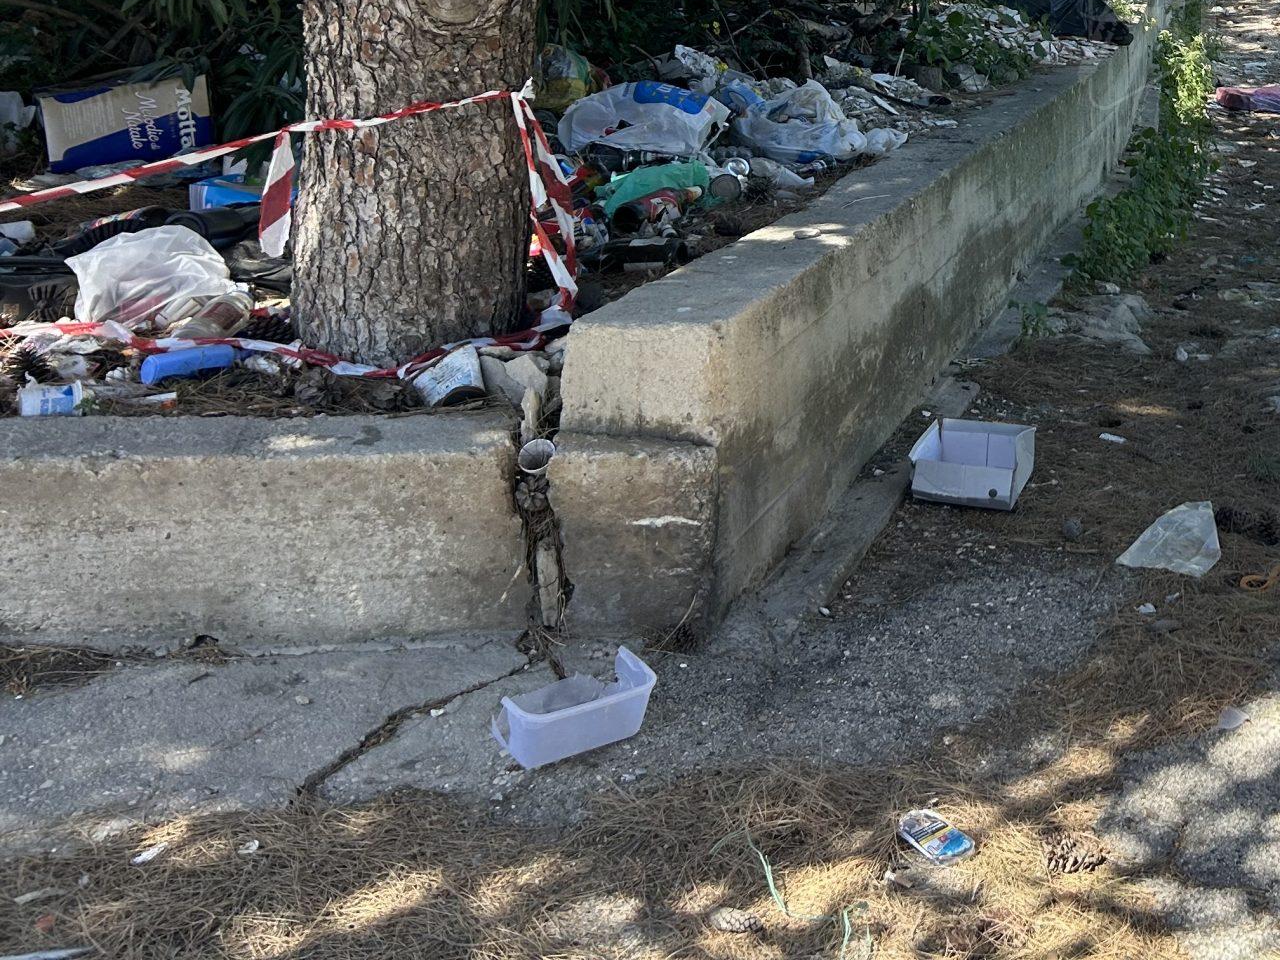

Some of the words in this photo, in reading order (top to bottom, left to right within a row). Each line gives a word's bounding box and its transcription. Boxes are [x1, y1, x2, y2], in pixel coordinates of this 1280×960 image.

[121, 107, 149, 150] Natale
[135, 91, 164, 145] Melodie
[174, 88, 197, 147] Motta
